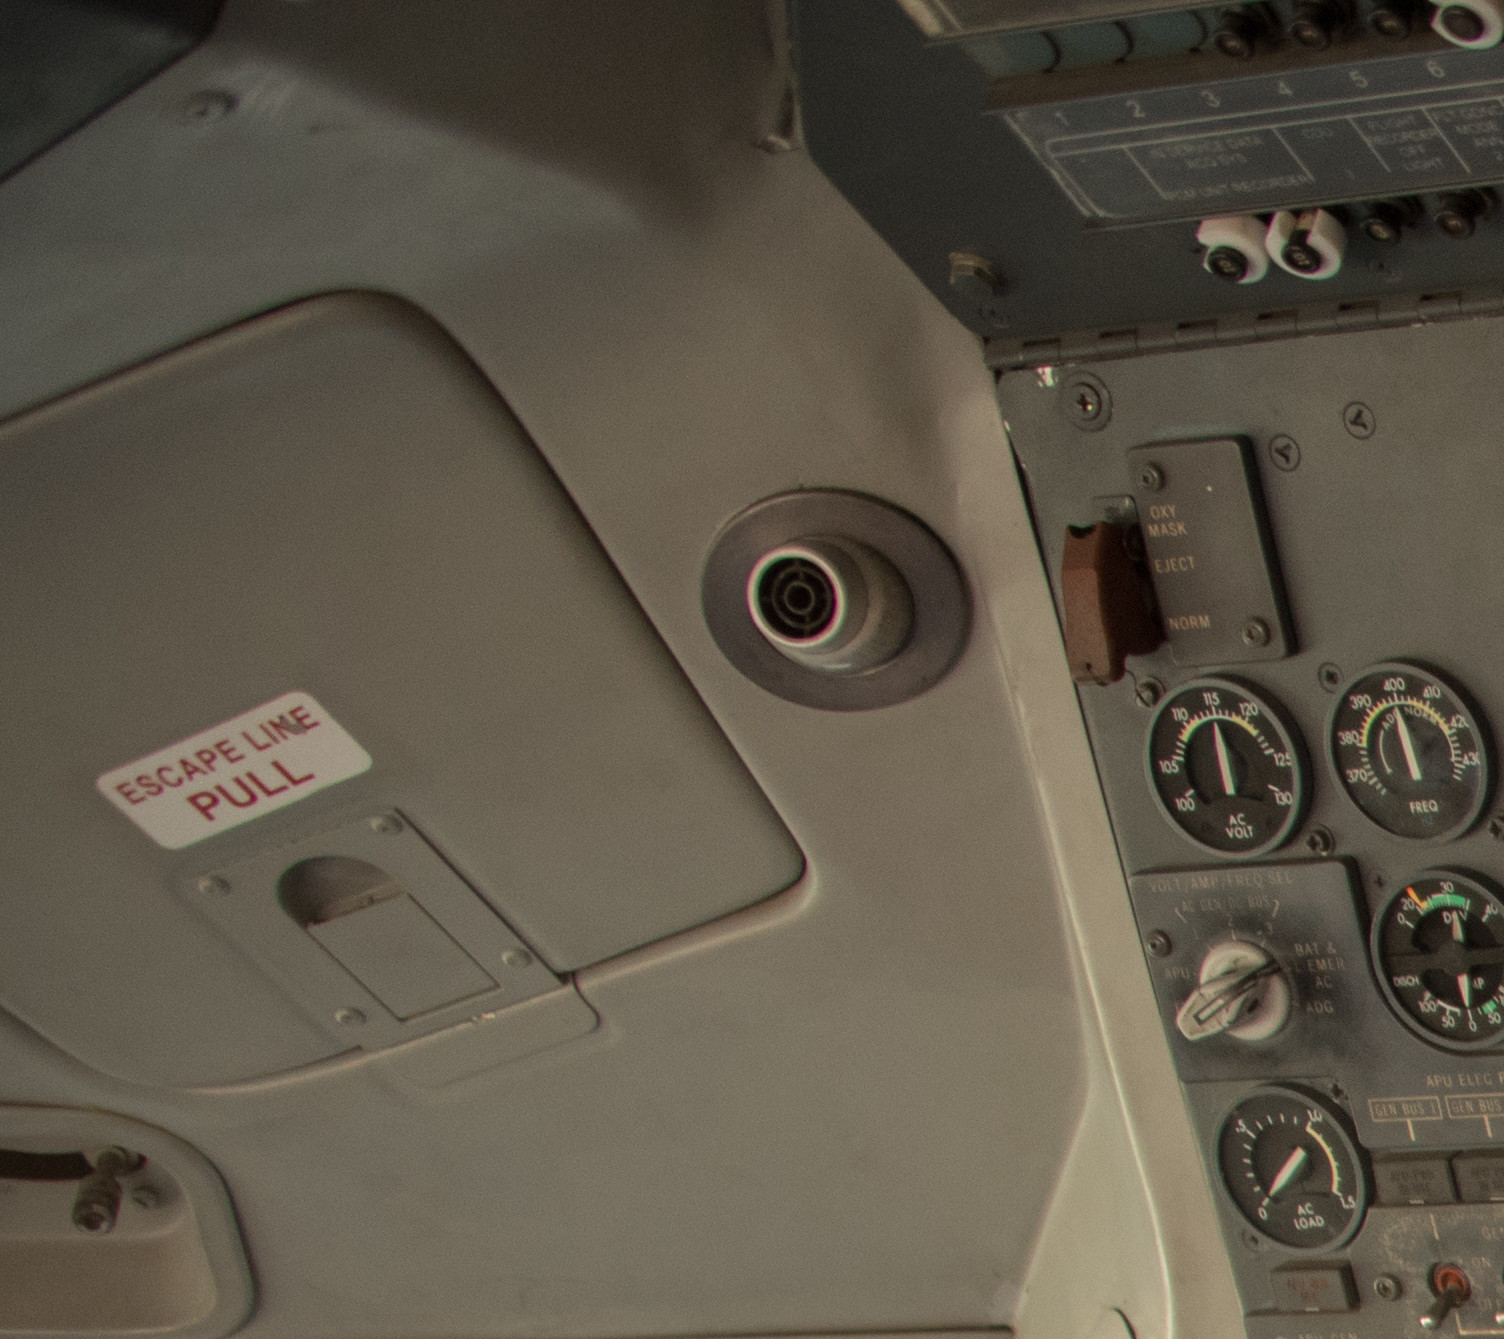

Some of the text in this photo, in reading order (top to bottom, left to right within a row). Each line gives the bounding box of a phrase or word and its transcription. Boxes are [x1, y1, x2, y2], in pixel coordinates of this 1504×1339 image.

[1149, 504, 1177, 519] OXY
[1148, 521, 1188, 537] MASK
[1154, 555, 1195, 573] EJECT
[1168, 614, 1211, 630] NORM
[1383, 677, 1406, 692] 400
[115, 703, 322, 807] ESCAPE LINE
[186, 756, 315, 822] PULL
[1409, 800, 1439, 814] FREQ
[1228, 814, 1246, 827] AC
[1225, 824, 1254, 840] VOLT
